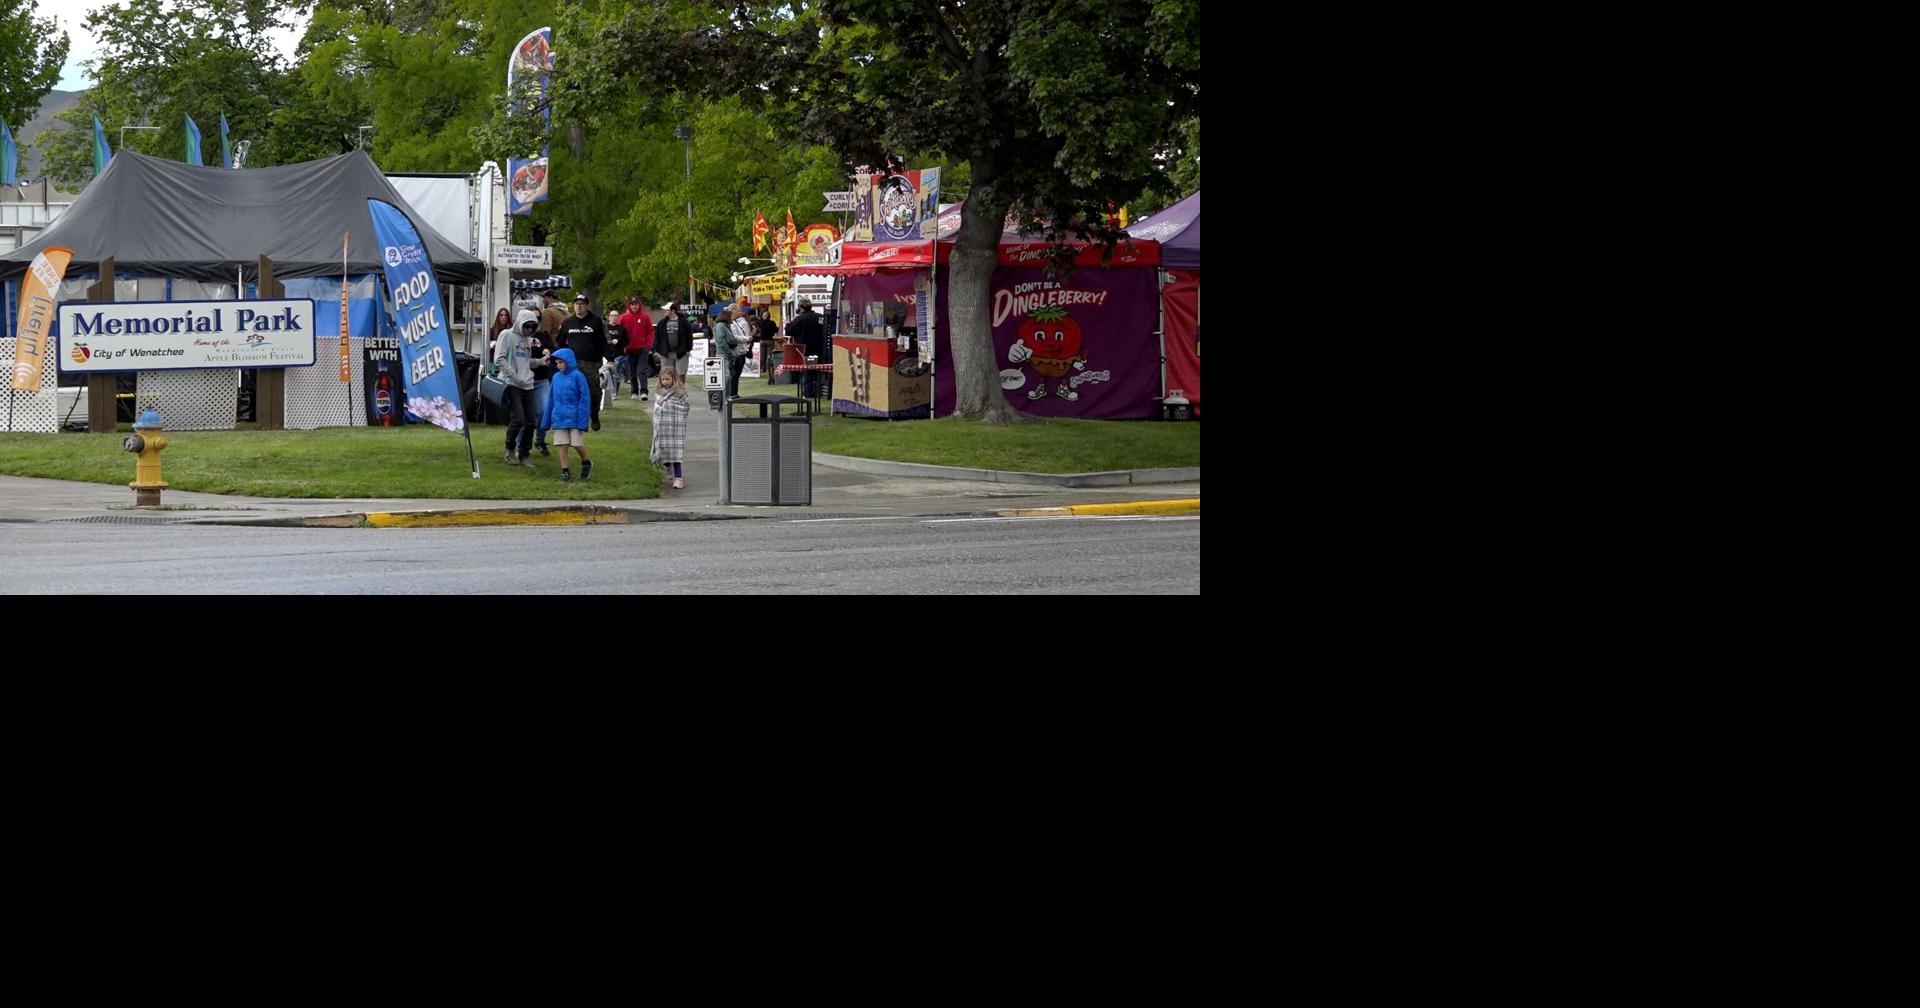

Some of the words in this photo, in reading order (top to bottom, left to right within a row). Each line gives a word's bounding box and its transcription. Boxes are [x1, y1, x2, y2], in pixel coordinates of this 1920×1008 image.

[394, 270, 430, 311] FOOD
[1015, 282, 1042, 295] DON'T
[72, 308, 223, 337] Memorial
[235, 307, 303, 334] Park
[992, 290, 1107, 328] DINGLEBERRY!
[401, 305, 440, 345] MUSIC
[93, 349, 112, 360] City
[115, 348, 127, 358] of
[129, 347, 184, 358] Wenatchee
[193, 338, 210, 346] Home
[211, 339, 219, 348] of
[220, 338, 231, 346] the
[369, 350, 398, 361] WITH
[411, 346, 445, 385] BEER
